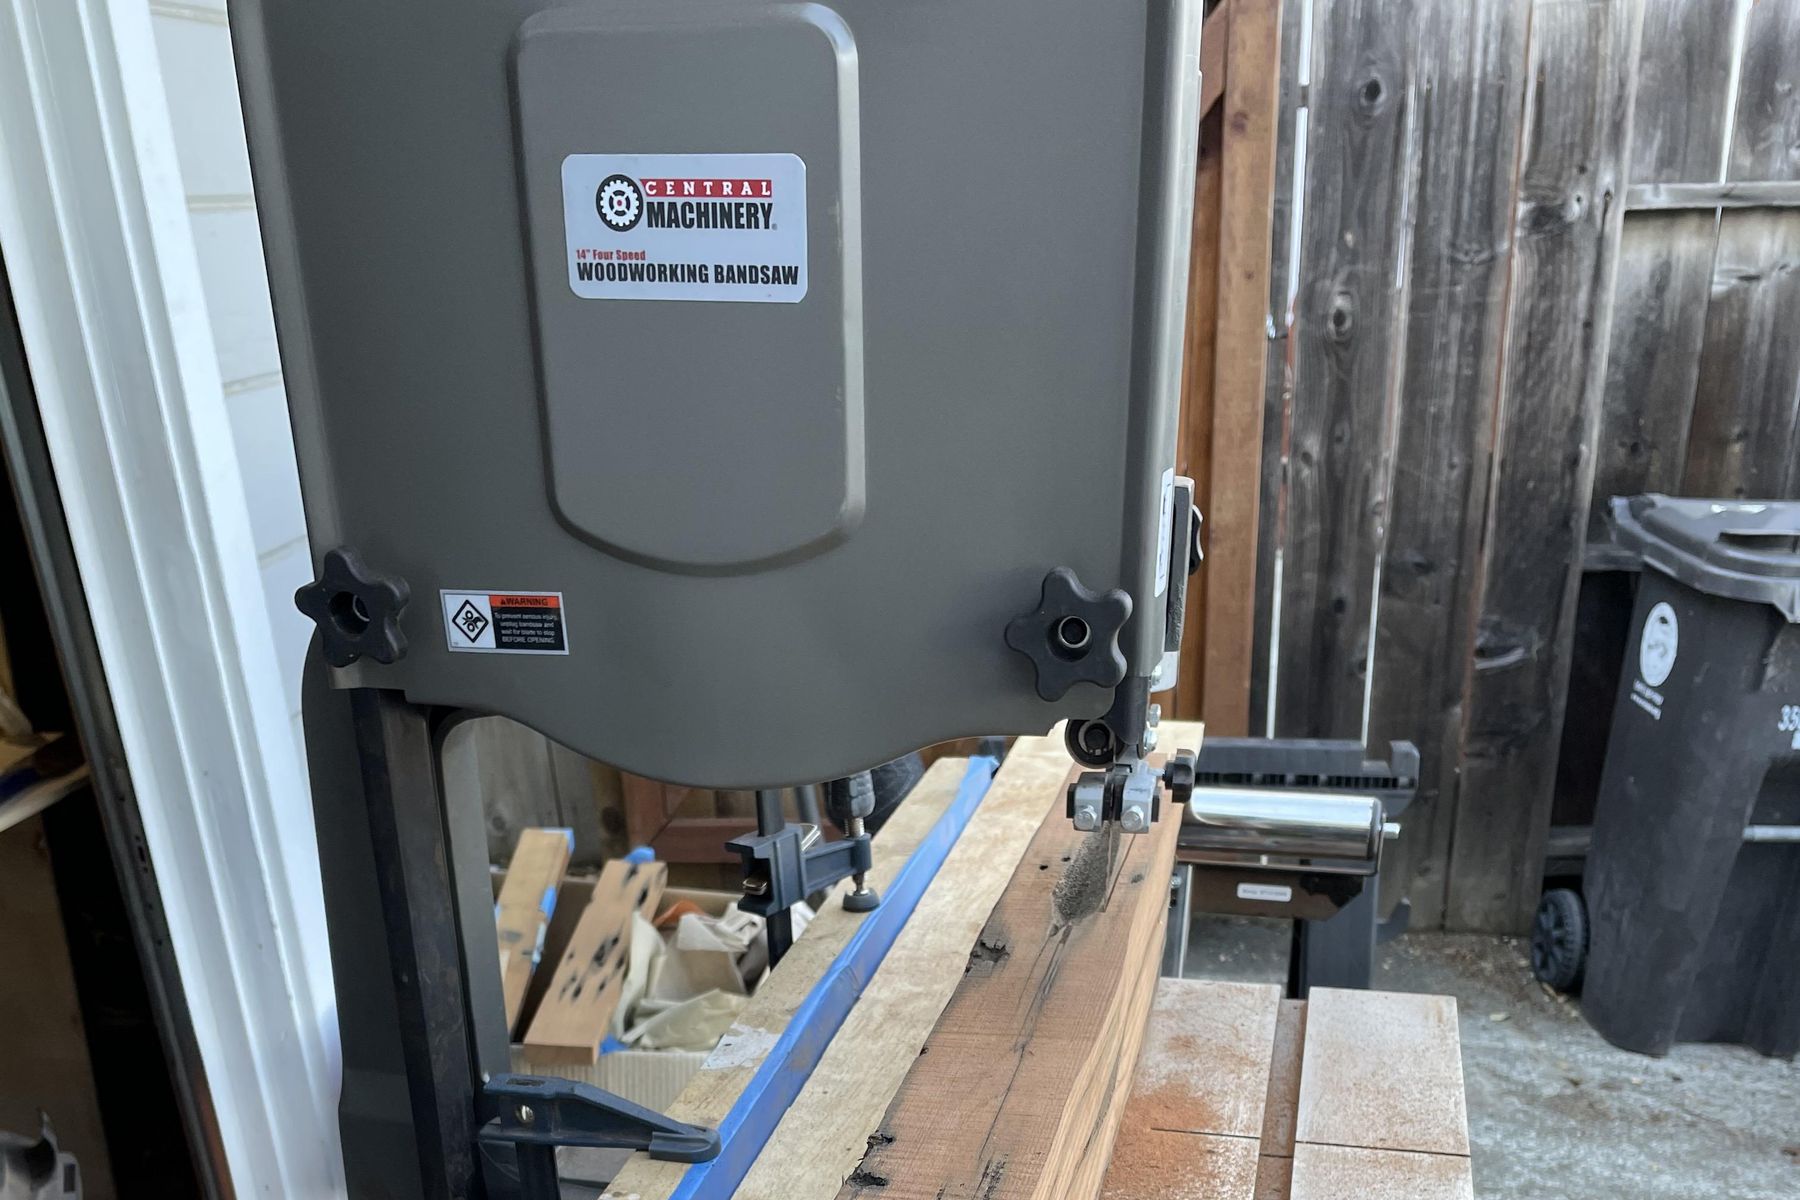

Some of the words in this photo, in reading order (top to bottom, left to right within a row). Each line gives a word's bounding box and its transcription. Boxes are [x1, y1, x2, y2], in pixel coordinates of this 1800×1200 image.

[645, 180, 771, 196] CENTRAL
[647, 201, 773, 230] MACHINERY
[593, 250, 614, 261] Four
[616, 250, 646, 263] Speed
[577, 262, 709, 284] WOODWORKING
[714, 264, 799, 286] BANDSAW
[506, 598, 548, 606] WARNING
